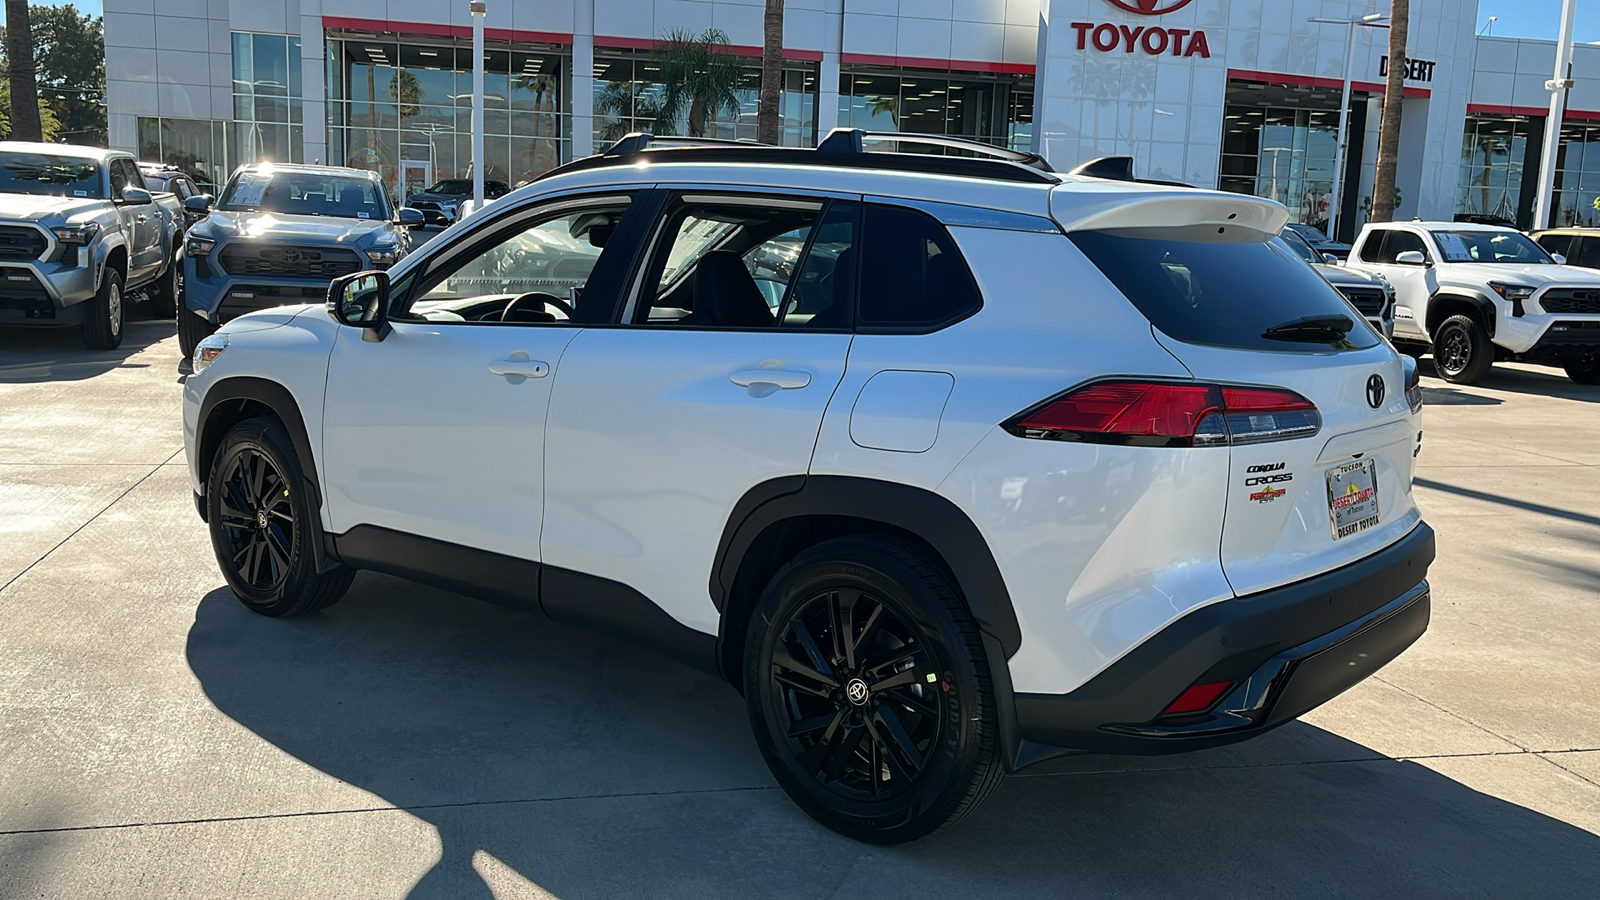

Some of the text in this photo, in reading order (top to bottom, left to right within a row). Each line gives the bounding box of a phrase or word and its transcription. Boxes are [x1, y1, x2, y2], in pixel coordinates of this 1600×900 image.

[1071, 22, 1211, 58] TOYOTA
[1379, 55, 1436, 82] DSERT
[1246, 462, 1285, 473] COROLLA
[1340, 462, 1364, 473] TUCSON
[1245, 473, 1293, 486] CROSS
[1333, 494, 1353, 510] DESERT
[1338, 515, 1379, 539] DESERT TOYOTA
